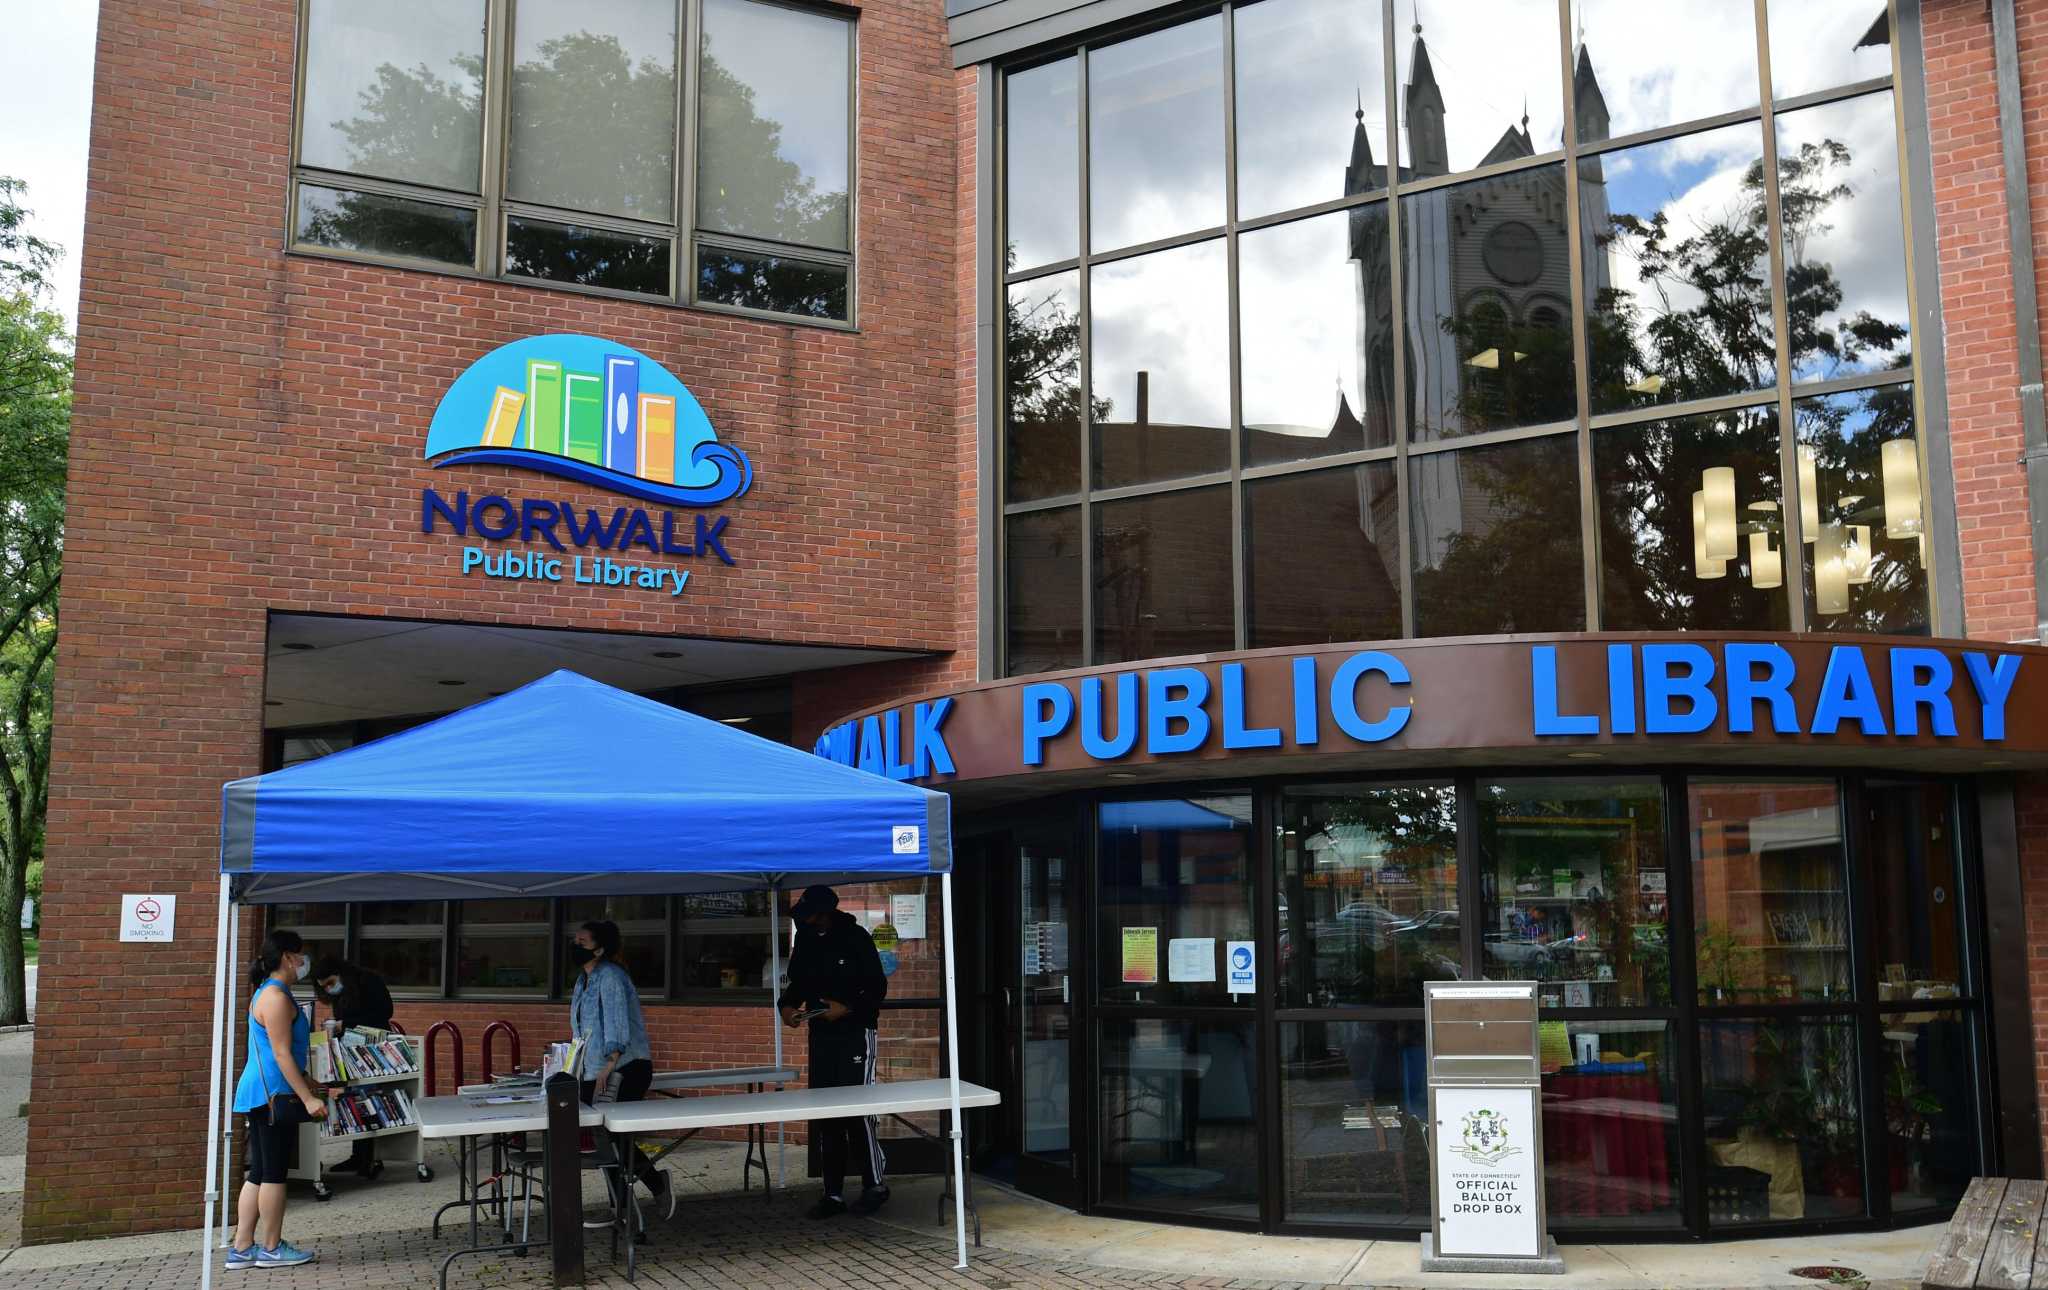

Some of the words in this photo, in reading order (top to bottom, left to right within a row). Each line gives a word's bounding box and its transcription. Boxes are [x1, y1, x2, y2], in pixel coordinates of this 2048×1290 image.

[422, 488, 735, 566] NORWALK
[462, 547, 563, 582] Public
[574, 555, 690, 596] Library
[1022, 651, 1412, 766] PUBLIC
[1531, 643, 2023, 740] LIBRARY
[1456, 1180, 1518, 1190] OFFICIAL
[1461, 1192, 1513, 1202] BALLOT
[1453, 1203, 1490, 1213] DROP
[1495, 1204, 1522, 1214] BOX
